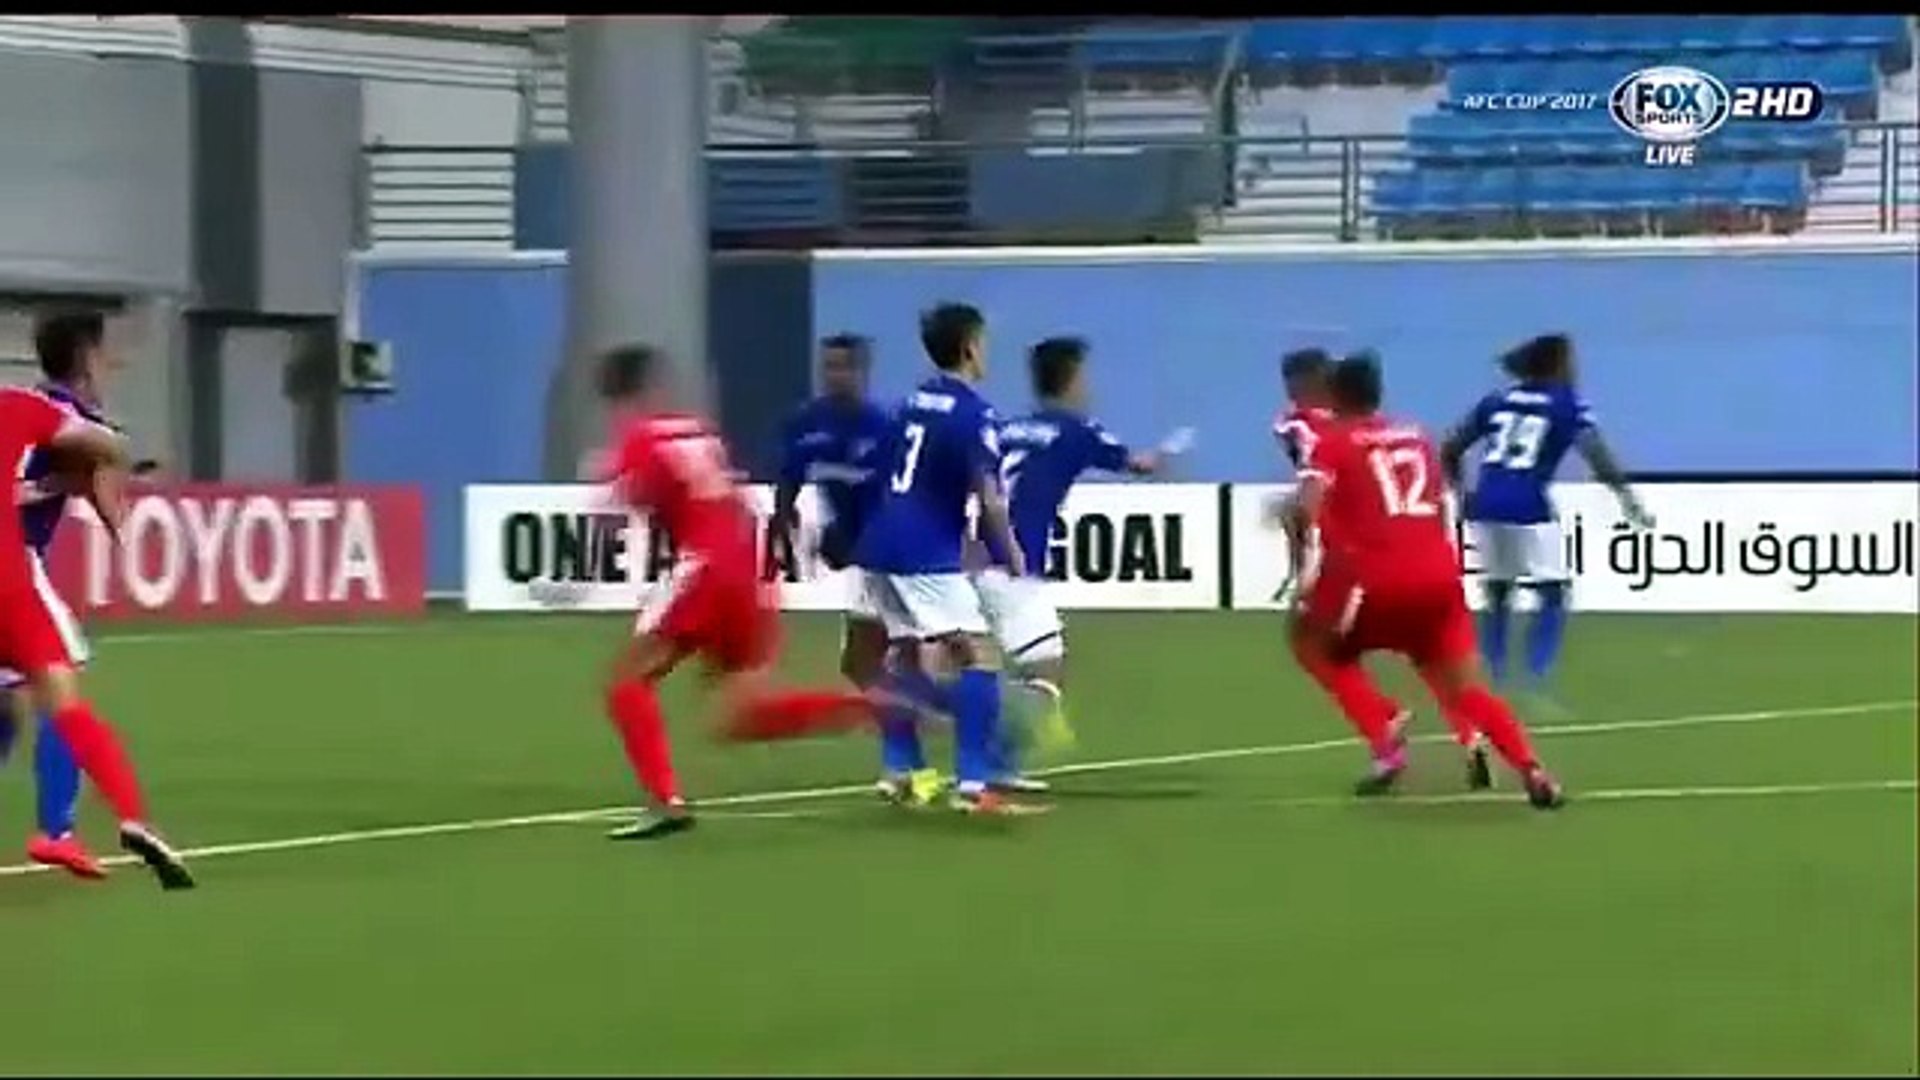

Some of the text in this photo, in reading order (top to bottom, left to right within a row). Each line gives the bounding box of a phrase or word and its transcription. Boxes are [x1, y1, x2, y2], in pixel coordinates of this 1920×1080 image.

[1367, 447, 1439, 516] 12
[66, 495, 386, 607] TOYOTA
[502, 512, 628, 582] ONE
[1738, 521, 1914, 592] السوق
